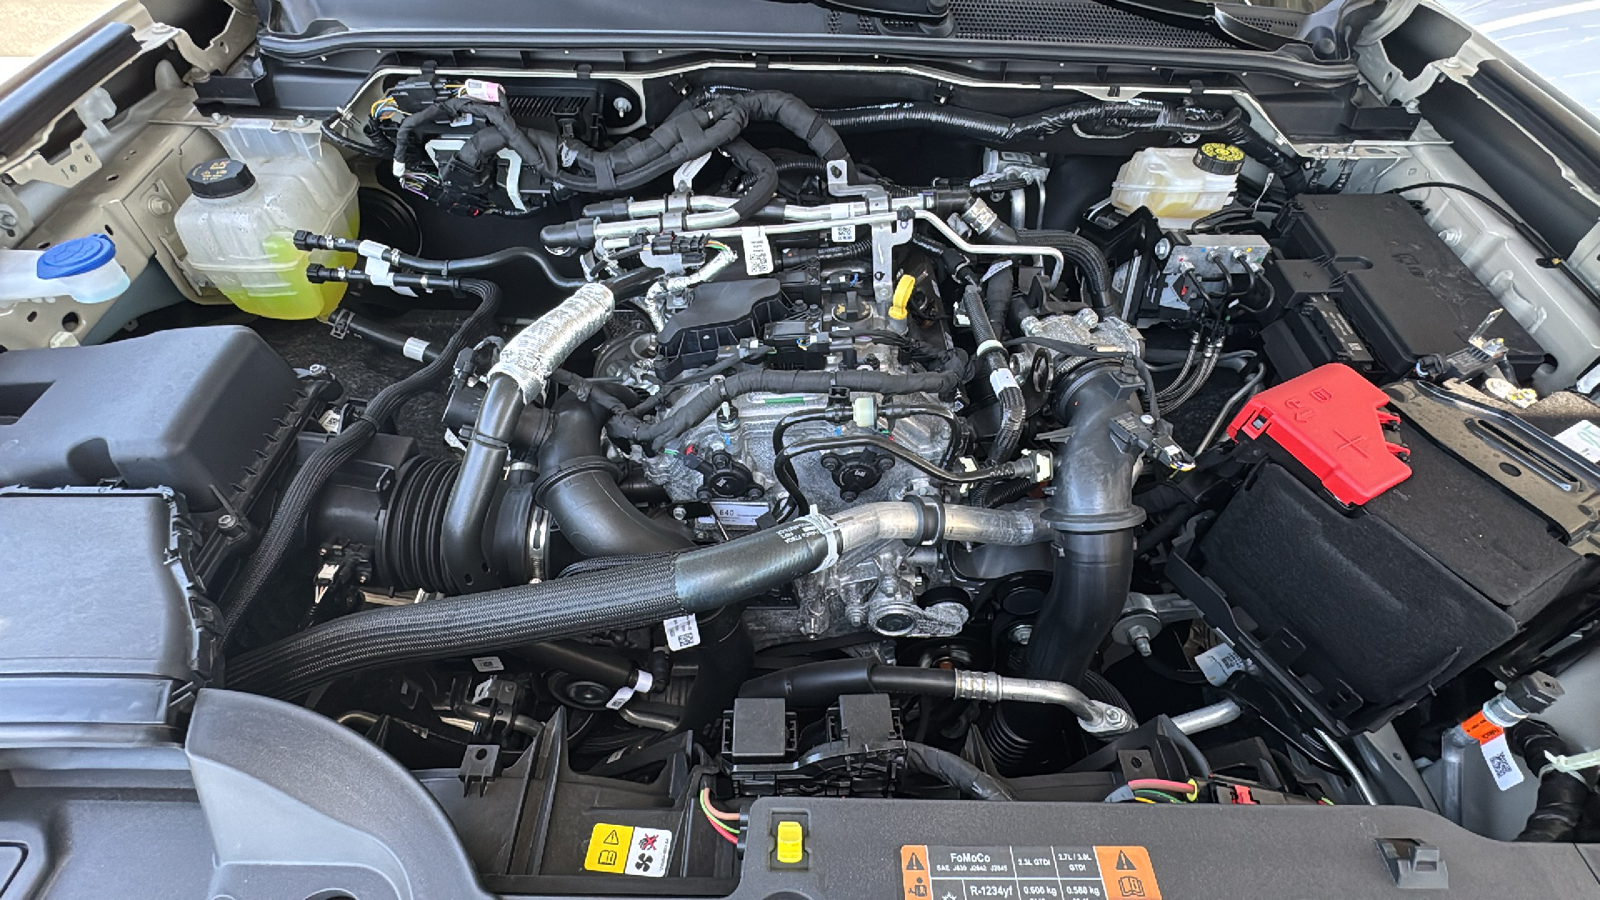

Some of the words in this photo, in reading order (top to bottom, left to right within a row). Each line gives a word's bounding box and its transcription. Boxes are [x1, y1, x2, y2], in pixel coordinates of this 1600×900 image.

[950, 853, 991, 862] FoMoCo
[969, 885, 1013, 898] R-1234yf
[1046, 886, 1057, 897] kg
[1089, 886, 1101, 897] kg
